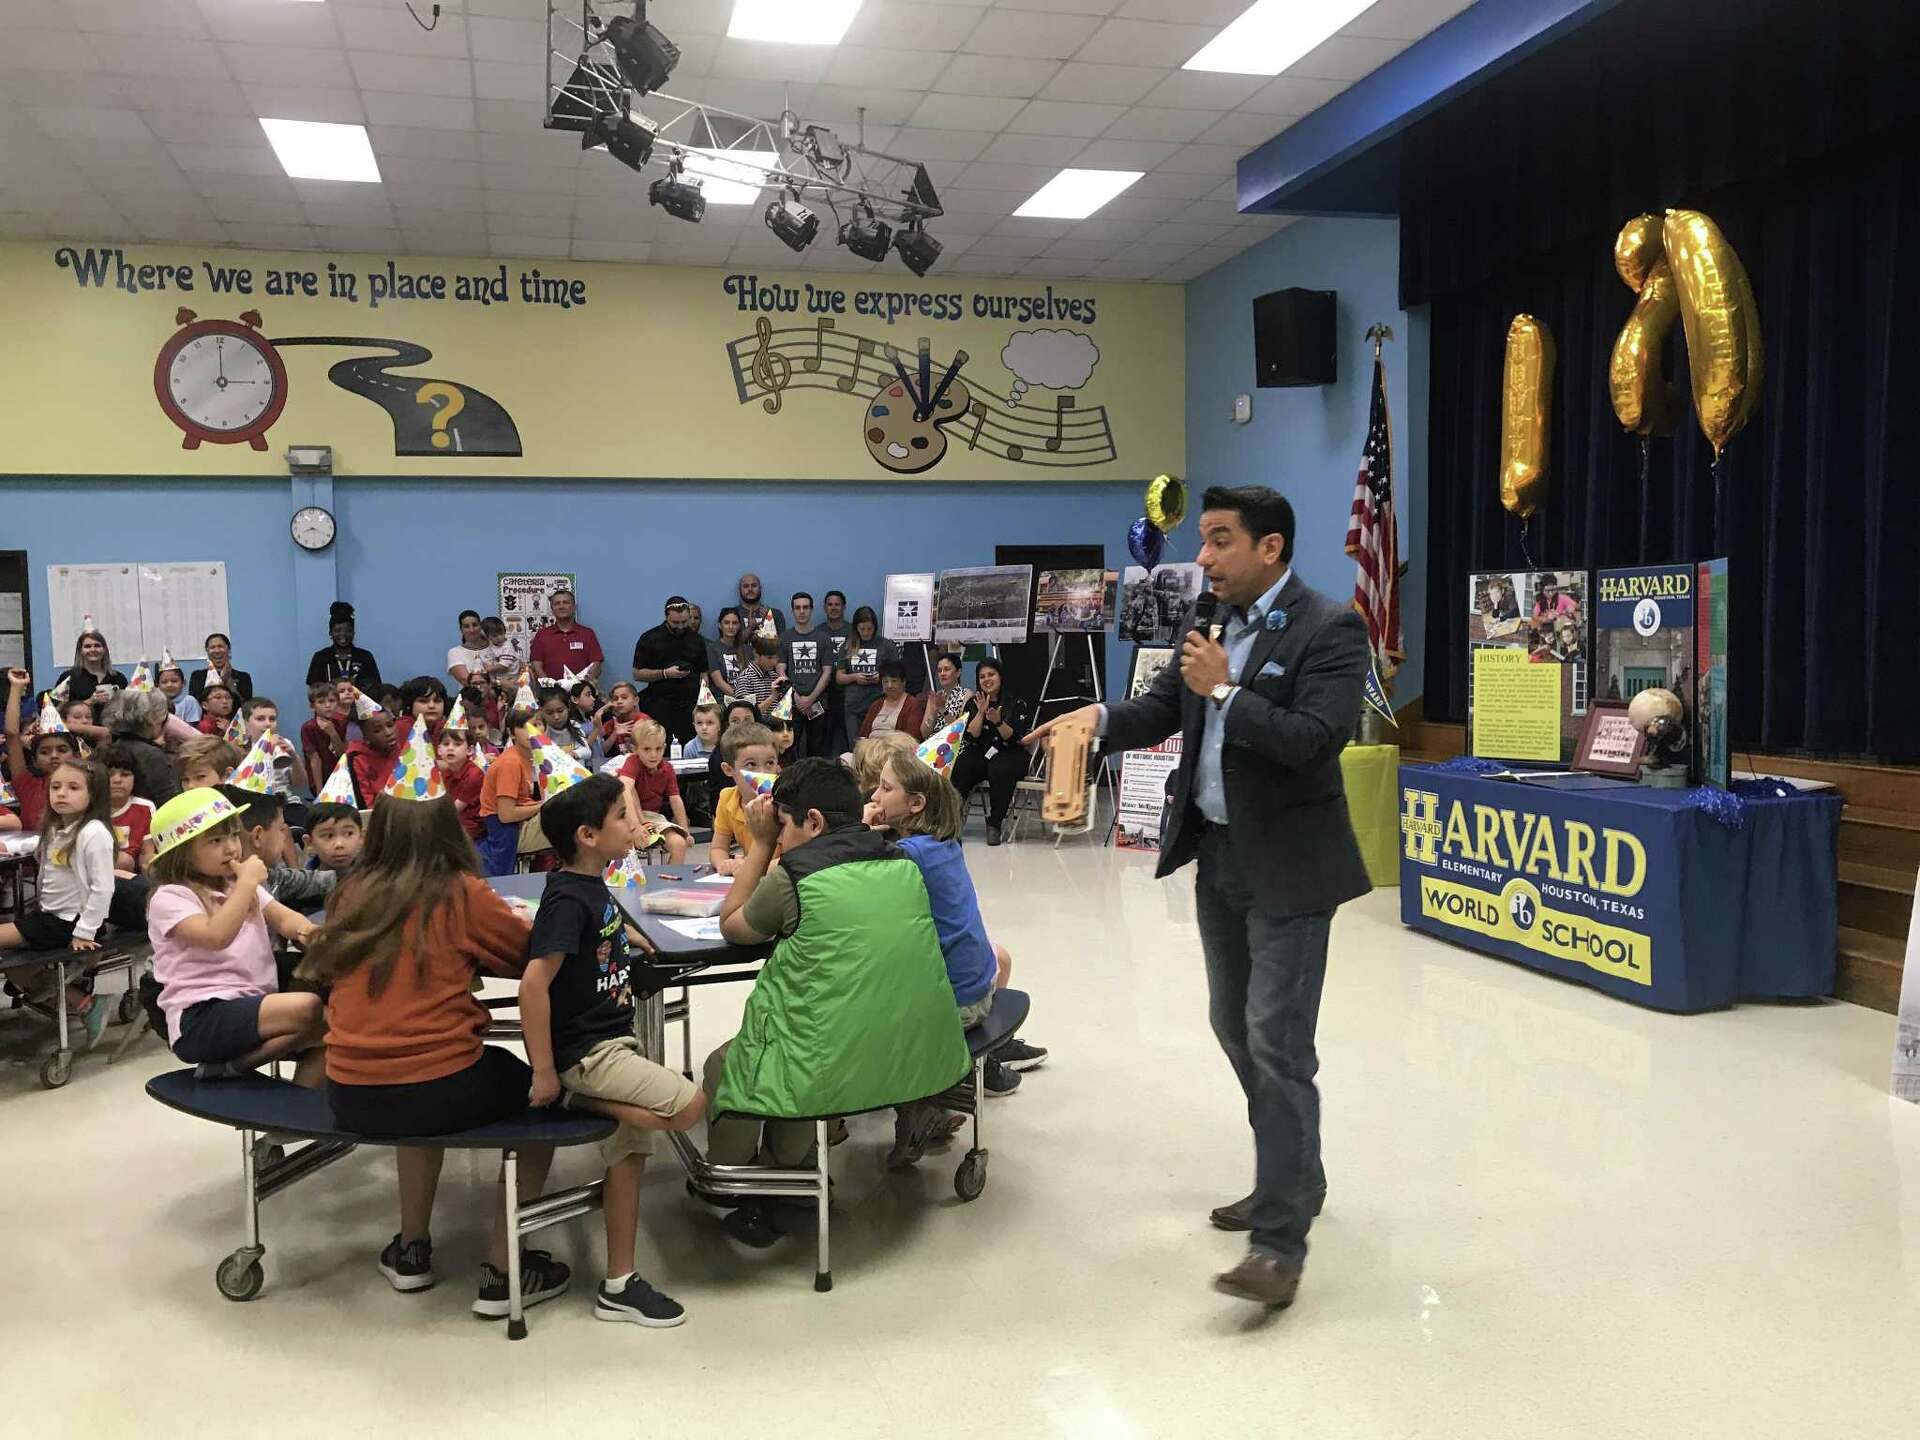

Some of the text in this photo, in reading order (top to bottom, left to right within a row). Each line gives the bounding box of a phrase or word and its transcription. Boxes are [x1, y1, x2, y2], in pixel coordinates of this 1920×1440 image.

[55, 247, 586, 309] Where we are in place and time
[723, 275, 1097, 324] How we express ourselves
[1599, 574, 1691, 602] HARVARD
[1479, 654, 1522, 663] HISTORY
[1400, 788, 1647, 898] HARVARD
[1402, 818, 1441, 836] HARVARD
[1443, 859, 1645, 920] ELEMENTARY HOUSTON, TEXAS
[1425, 887, 1500, 926] WORLD
[1541, 919, 1641, 970] SCHOOL
